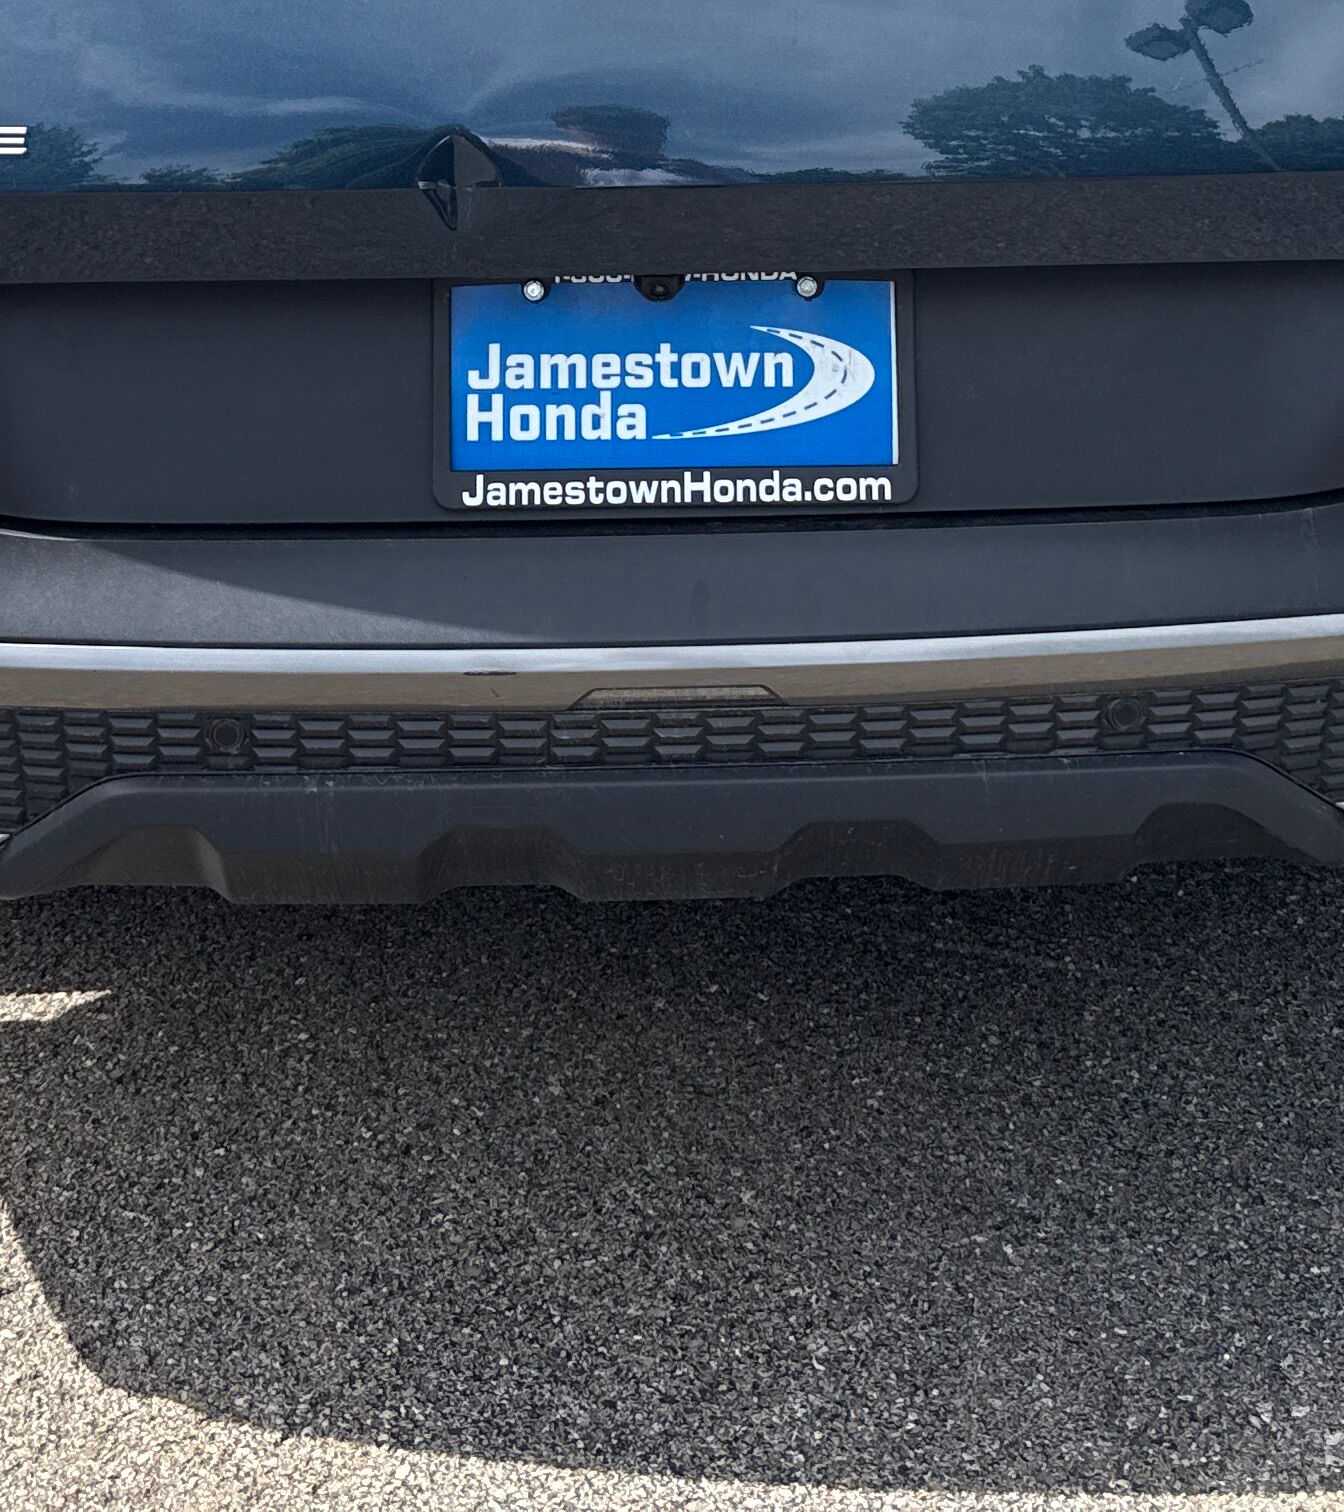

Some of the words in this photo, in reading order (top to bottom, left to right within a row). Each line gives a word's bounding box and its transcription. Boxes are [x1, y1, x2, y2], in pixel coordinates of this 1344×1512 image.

[467, 343, 793, 389] Jamestown
[466, 391, 647, 441] Honda
[461, 470, 892, 506] JamestownHonda.com
